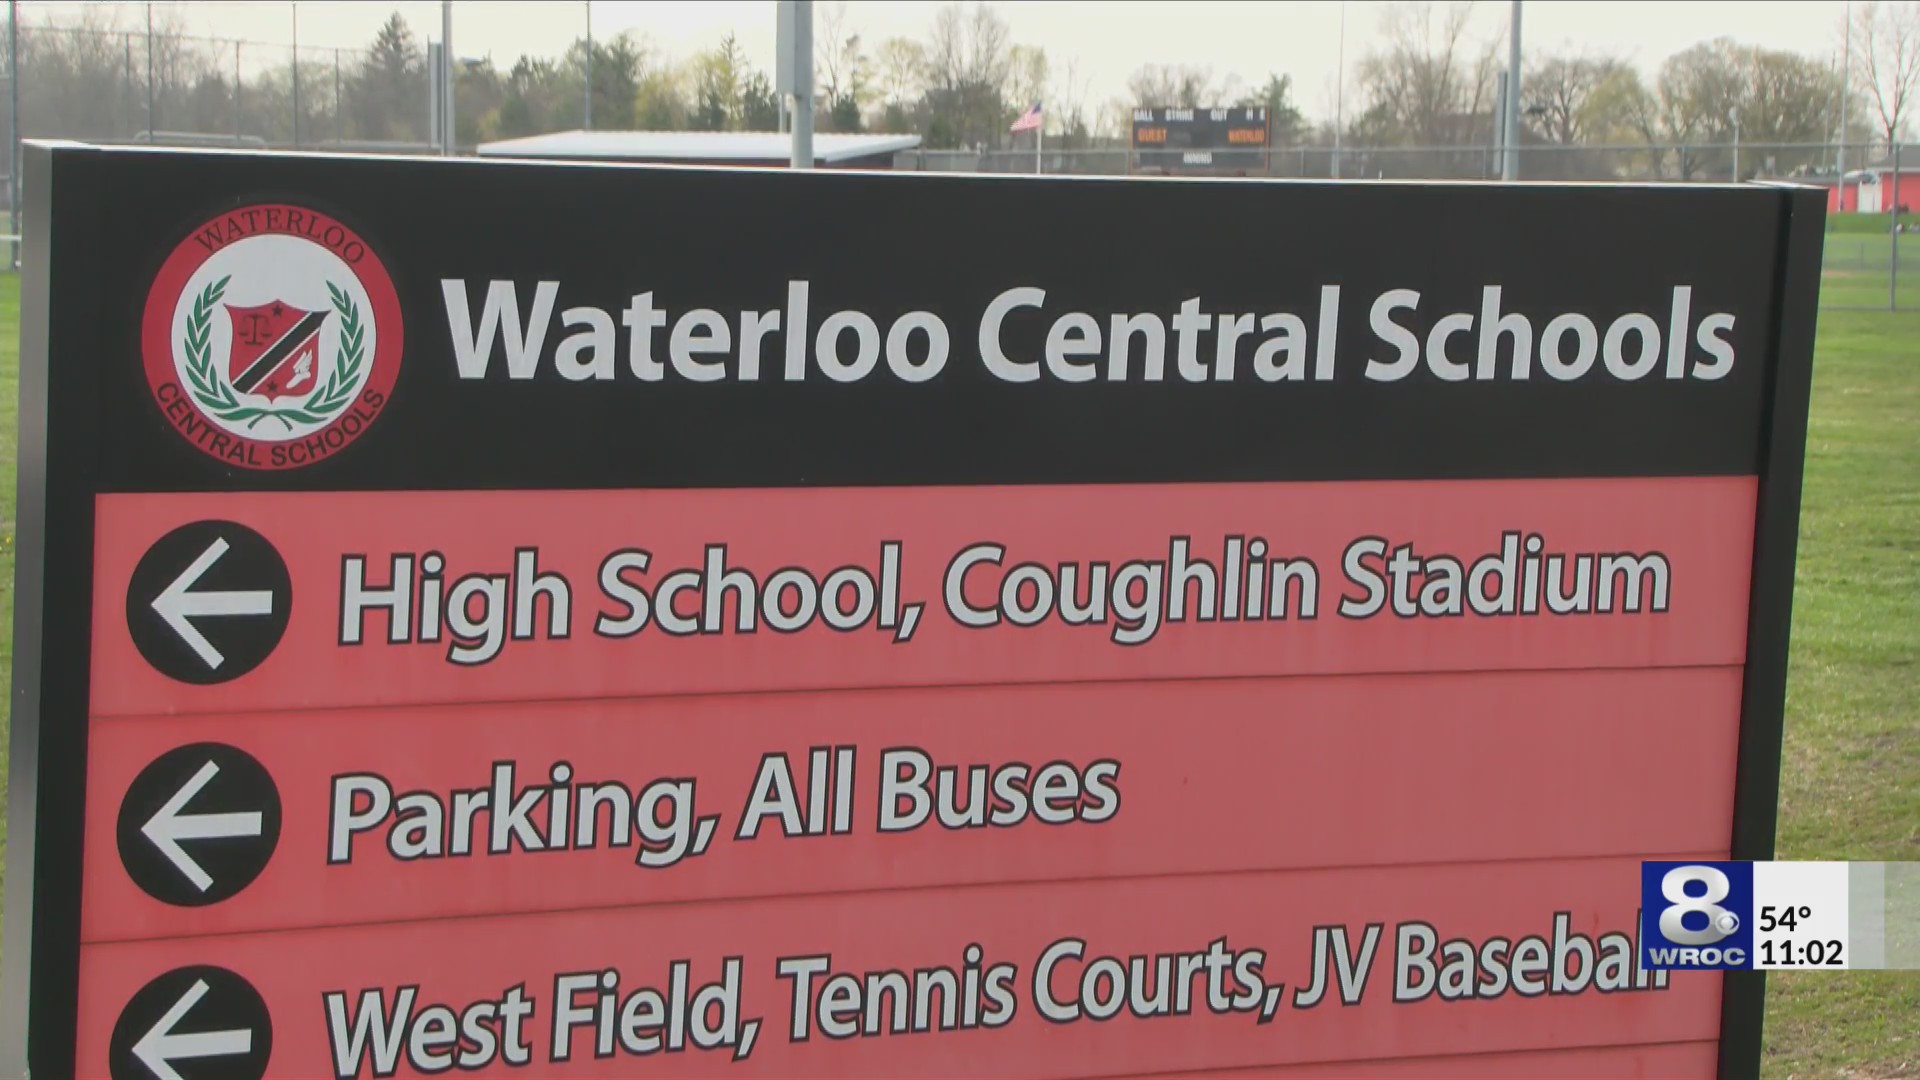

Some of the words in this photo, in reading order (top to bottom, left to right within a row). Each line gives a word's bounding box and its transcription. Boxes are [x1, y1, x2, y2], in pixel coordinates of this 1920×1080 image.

[193, 207, 365, 266] WATERLOO
[440, 278, 951, 383] Waterloo
[978, 284, 1341, 383] Central
[1364, 284, 1737, 382] Schools
[157, 383, 262, 466] CENTRAL
[270, 389, 384, 467] SCHOOLS
[337, 546, 573, 666] High
[593, 540, 926, 644] School,
[942, 535, 1320, 646] Coughlin
[1337, 530, 1671, 620] Stadium
[326, 760, 721, 868] Parking,
[734, 744, 857, 841] All
[877, 745, 1122, 833] Buses
[322, 981, 535, 1080] West
[549, 956, 763, 1062] Field,
[776, 942, 1018, 1045] Tennis
[1031, 936, 1284, 1025] Courts,
[1292, 922, 1385, 1010] JV
[1391, 908, 1671, 1003] Baseba
